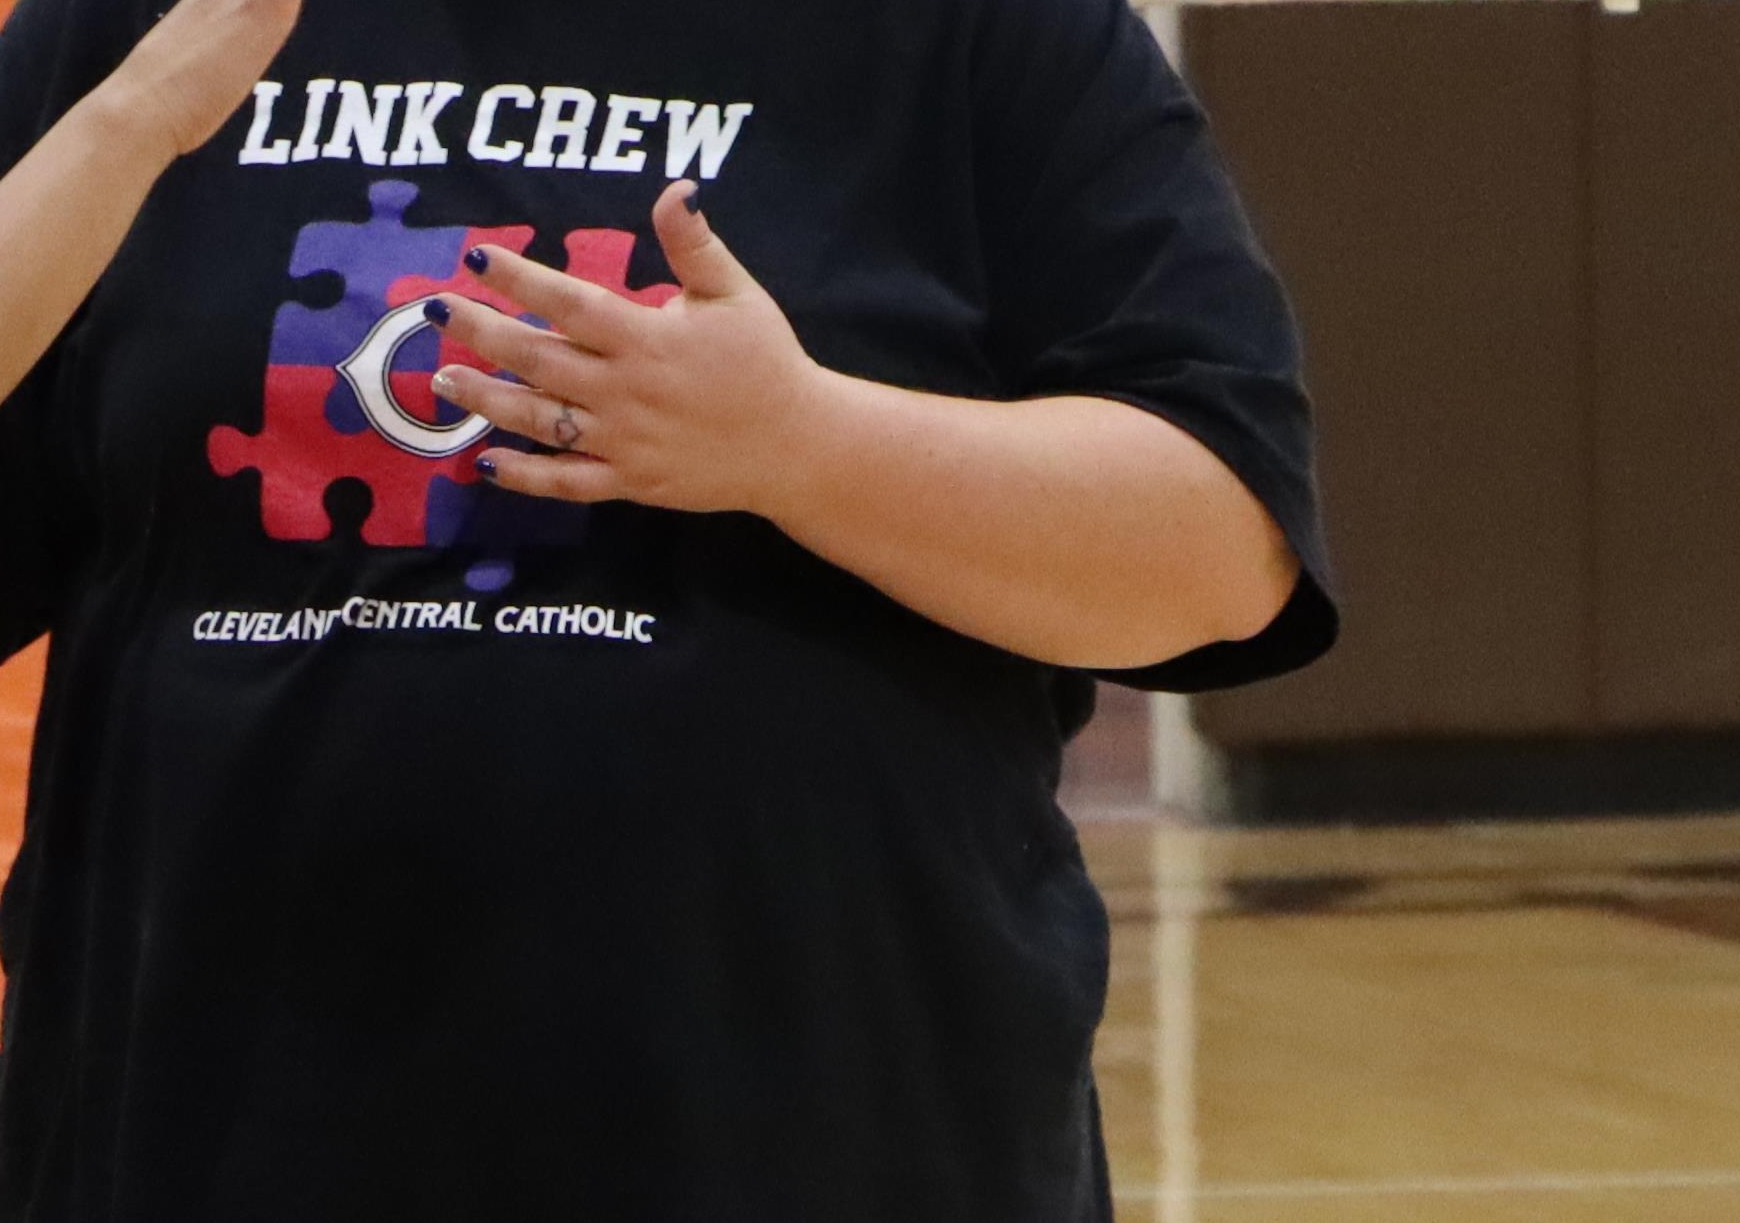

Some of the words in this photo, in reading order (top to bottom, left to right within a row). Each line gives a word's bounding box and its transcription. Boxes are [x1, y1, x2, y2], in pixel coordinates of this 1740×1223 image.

[238, 78, 464, 166] LINK
[467, 83, 755, 179] CREW
[341, 595, 483, 633] CENTRAL
[494, 603, 657, 645] CATHOLIC
